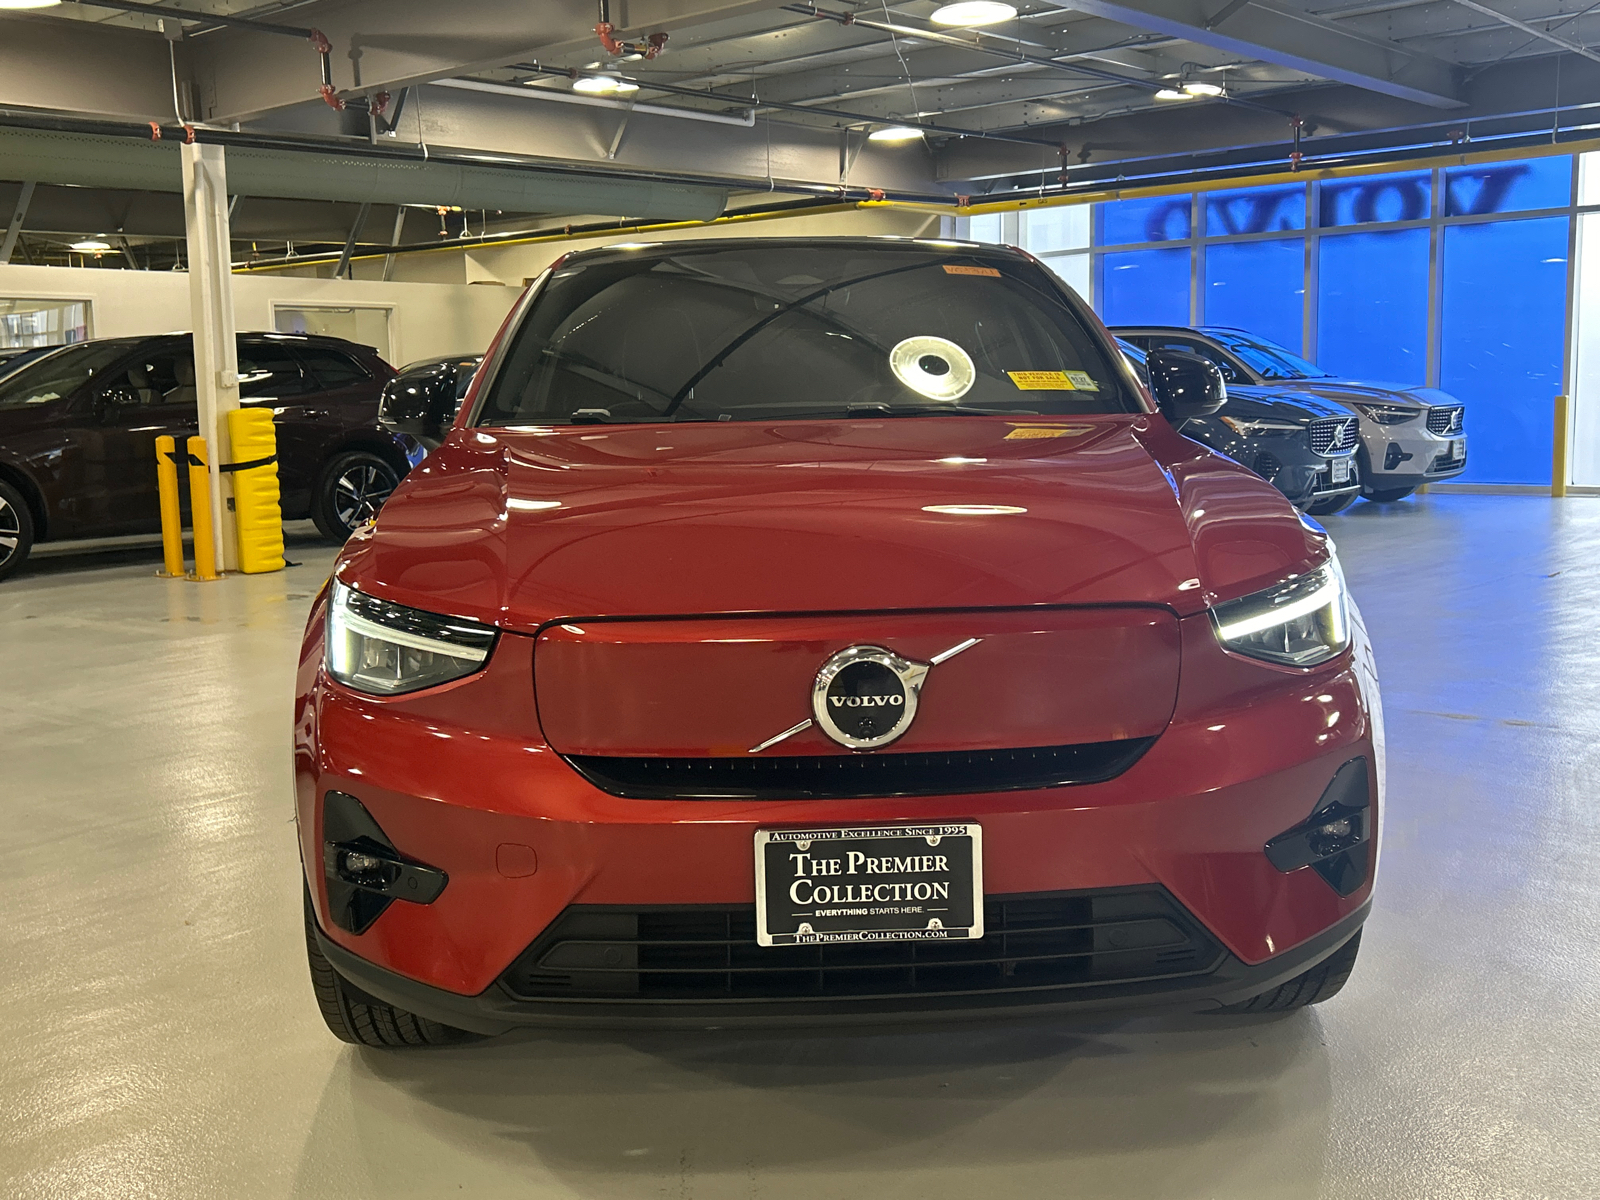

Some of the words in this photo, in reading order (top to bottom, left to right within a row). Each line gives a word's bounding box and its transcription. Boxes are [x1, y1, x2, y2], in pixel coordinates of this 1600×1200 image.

[828, 694, 904, 708] VOLVO
[771, 832, 838, 841] AUTOMOTIVE
[841, 829, 903, 838] EXCELLENCE
[905, 828, 935, 836] SINCE
[938, 826, 966, 835] 1995
[789, 853, 842, 877] THE
[846, 851, 950, 875] PREMIER
[789, 879, 950, 905] COLLECTION
[815, 908, 868, 917] EVERYTHING
[869, 907, 900, 915] STARTS
[900, 906, 925, 914] HERE.
